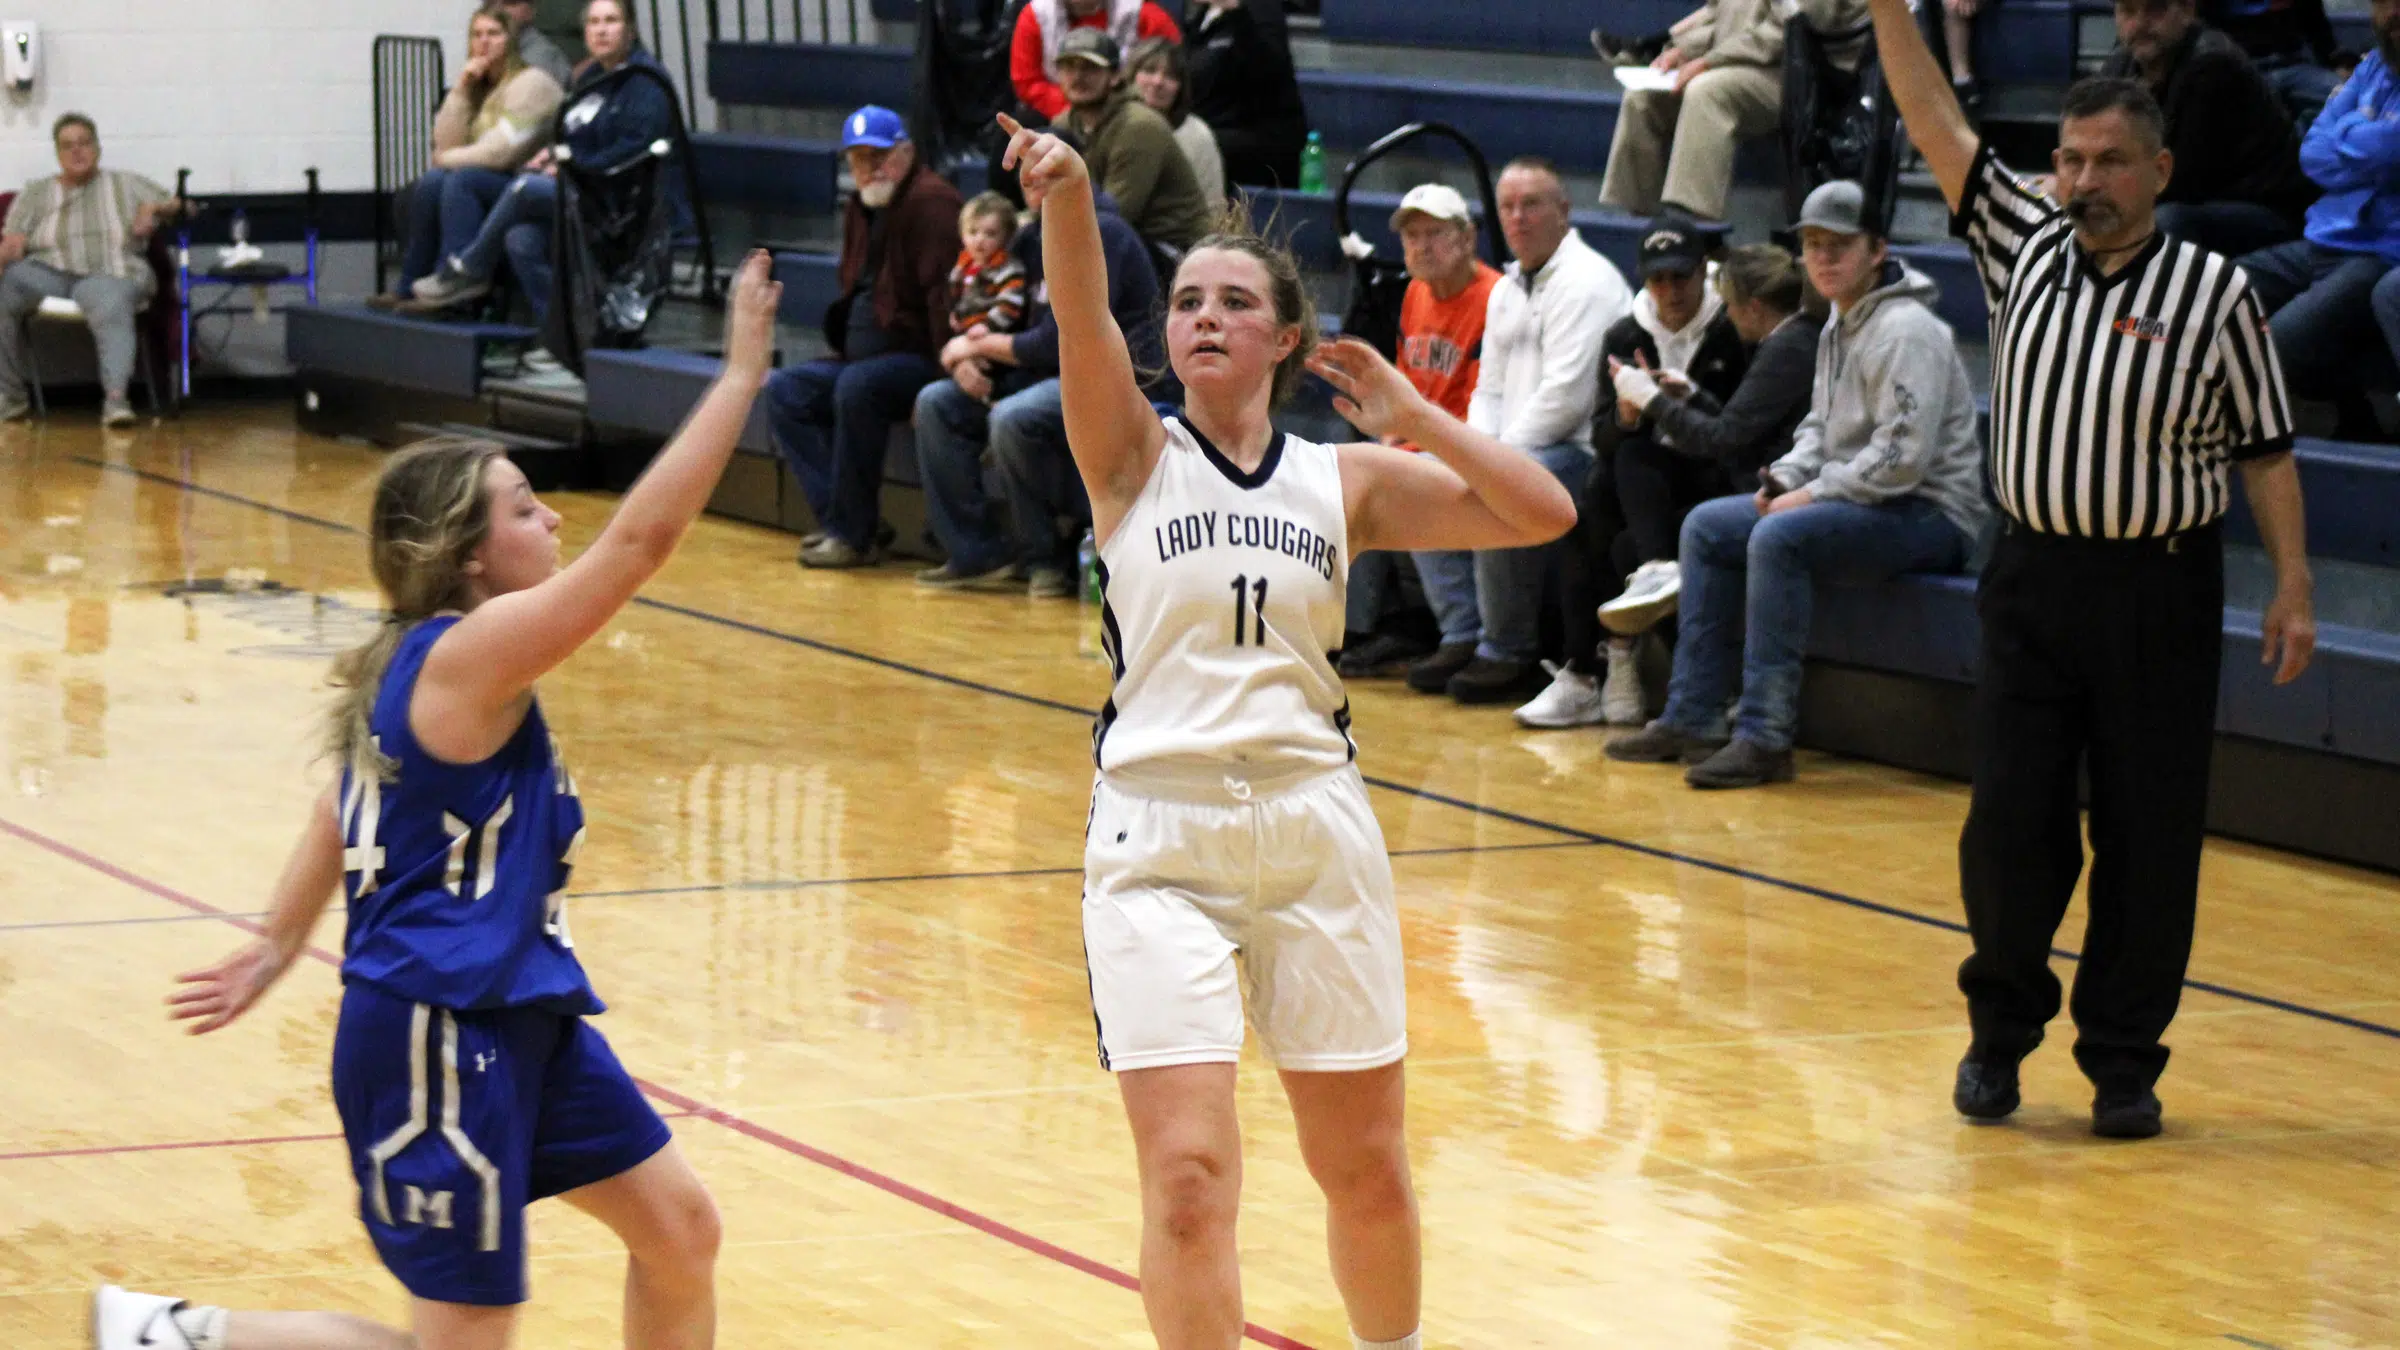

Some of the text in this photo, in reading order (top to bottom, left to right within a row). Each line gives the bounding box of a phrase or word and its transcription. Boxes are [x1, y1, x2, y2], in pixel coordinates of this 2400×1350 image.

[1155, 511, 1337, 581] LADY COUGARS
[1230, 573, 1268, 647] 11
[403, 1184, 456, 1229] M
